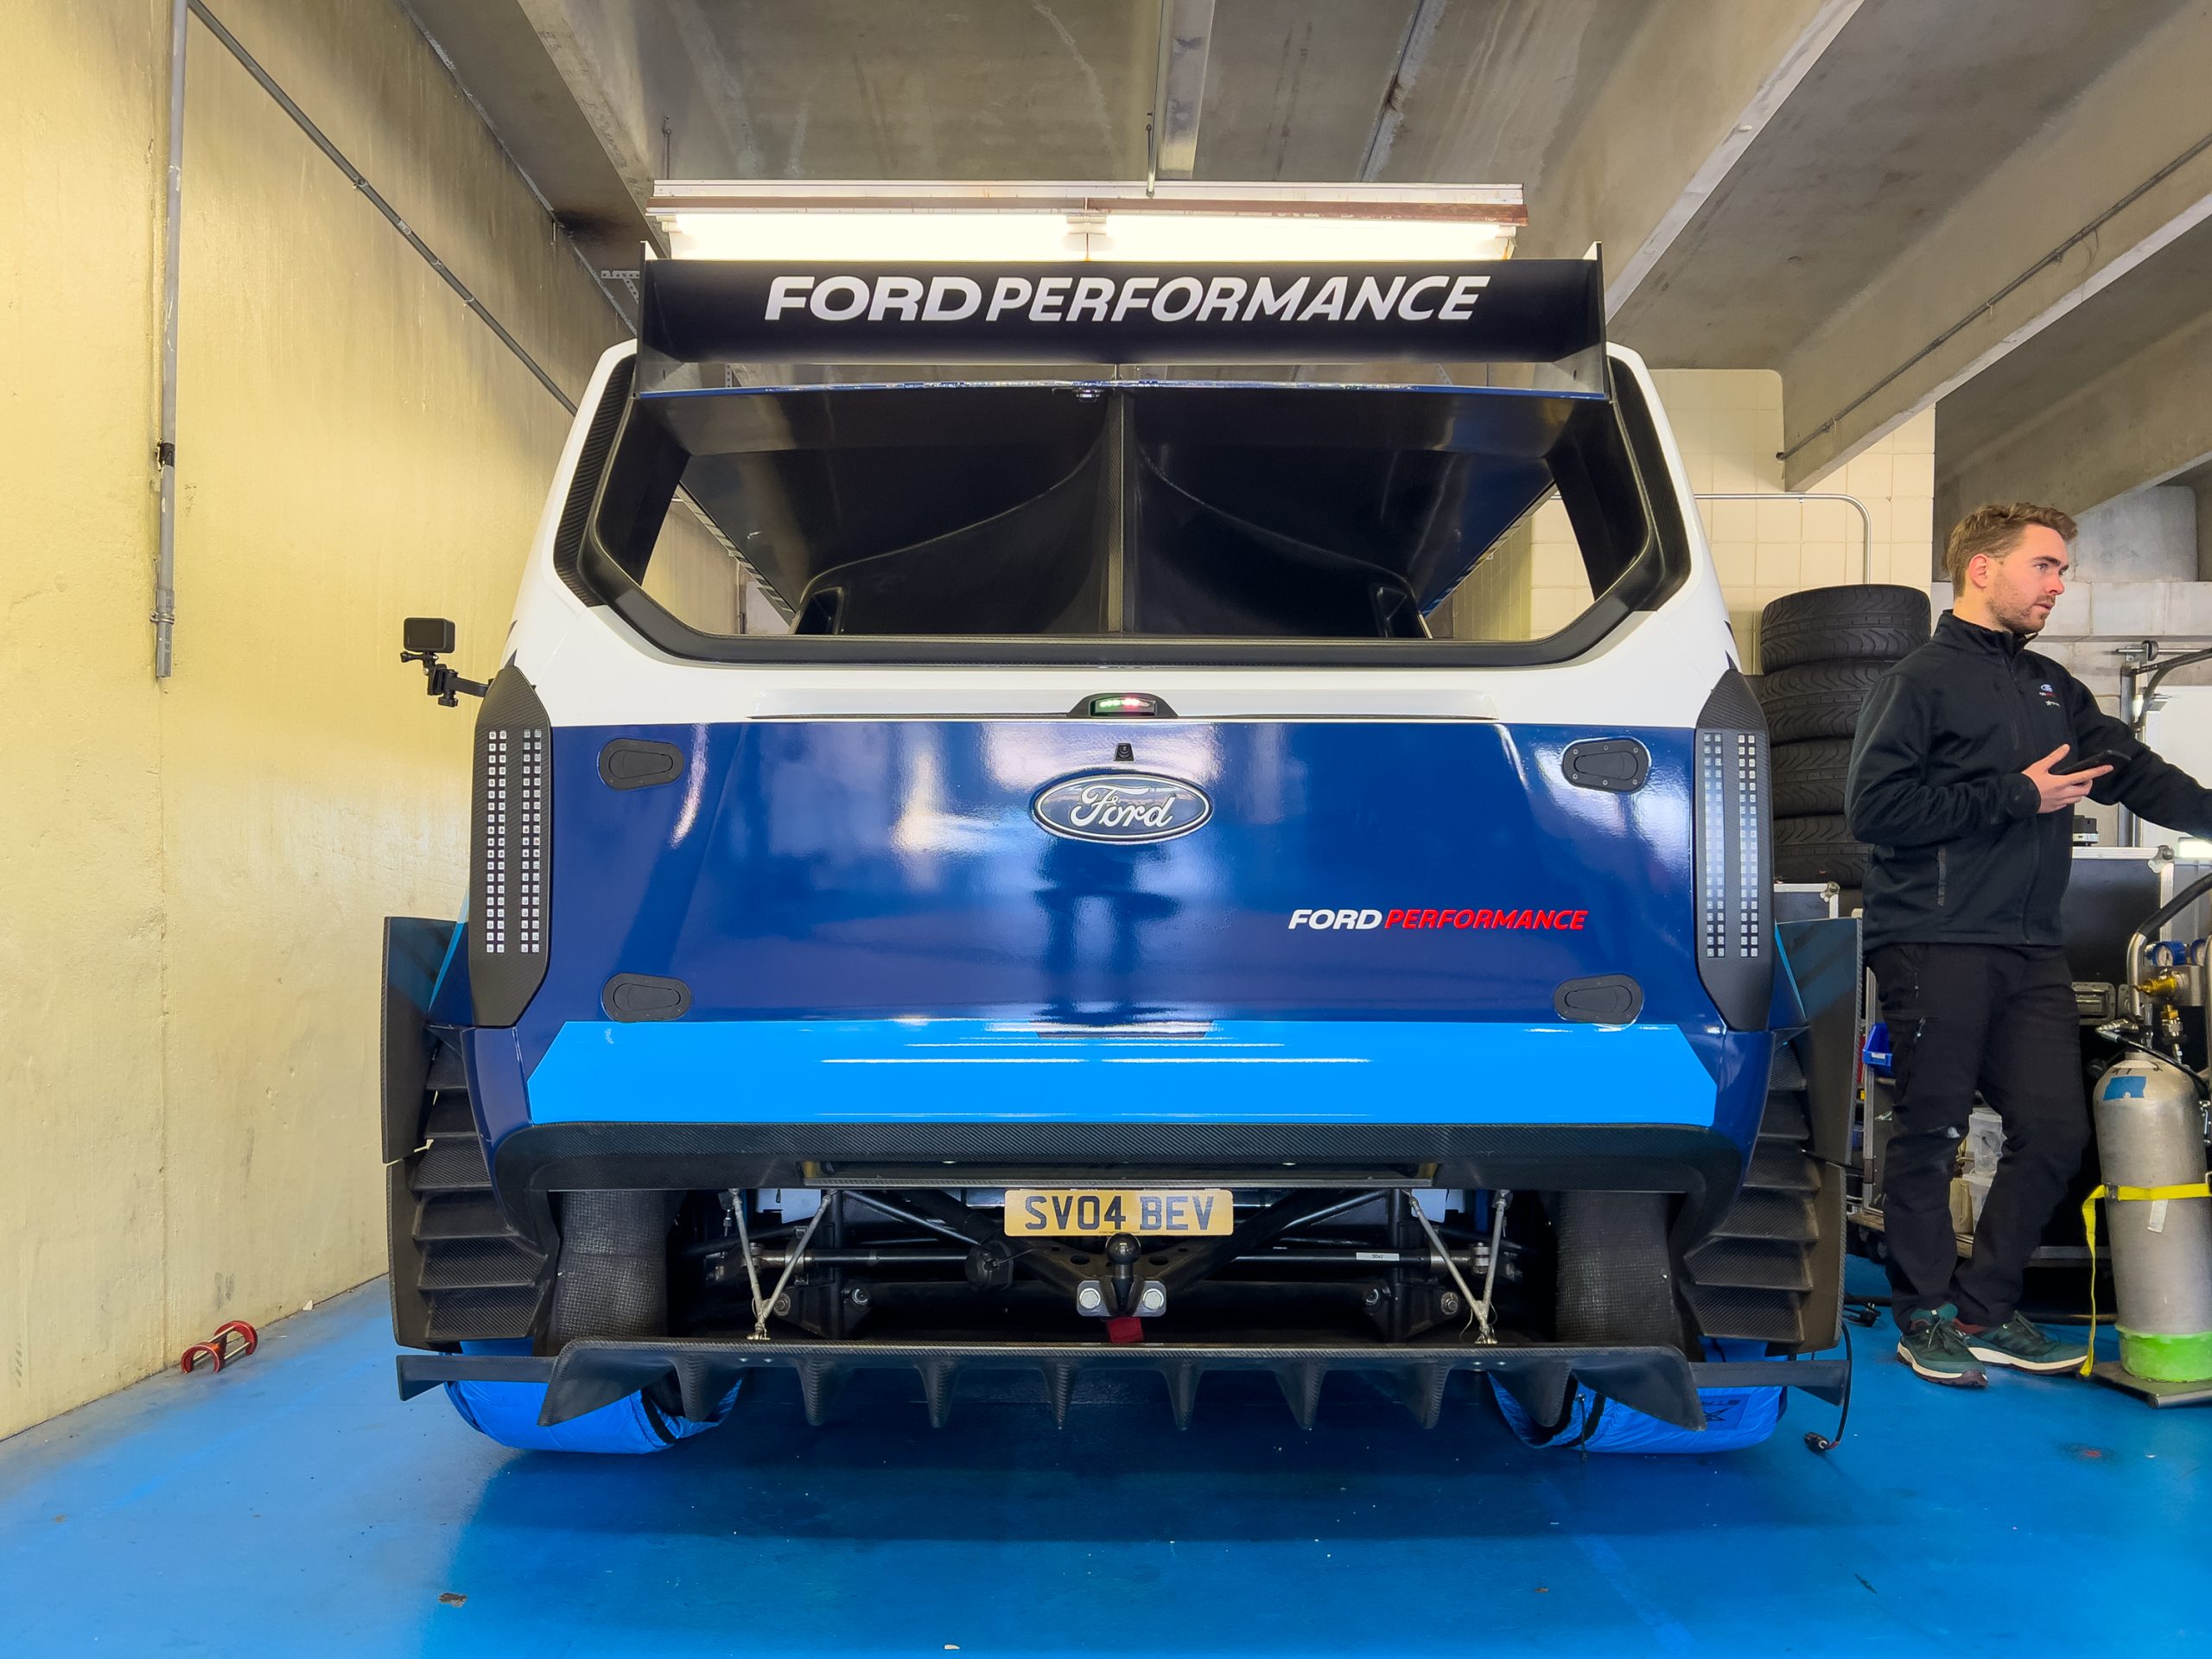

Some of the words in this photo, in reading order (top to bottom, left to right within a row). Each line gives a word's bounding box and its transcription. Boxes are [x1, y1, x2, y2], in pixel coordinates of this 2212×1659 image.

[764, 275, 982, 321] FORD
[985, 276, 1491, 322] PERFORMANCE
[1070, 784, 1177, 828] Ford
[1287, 909, 1382, 930] FORD
[1384, 909, 1588, 931] PERFORMANCE
[1025, 1195, 1127, 1230] SV04
[1139, 1195, 1215, 1230] BEV
